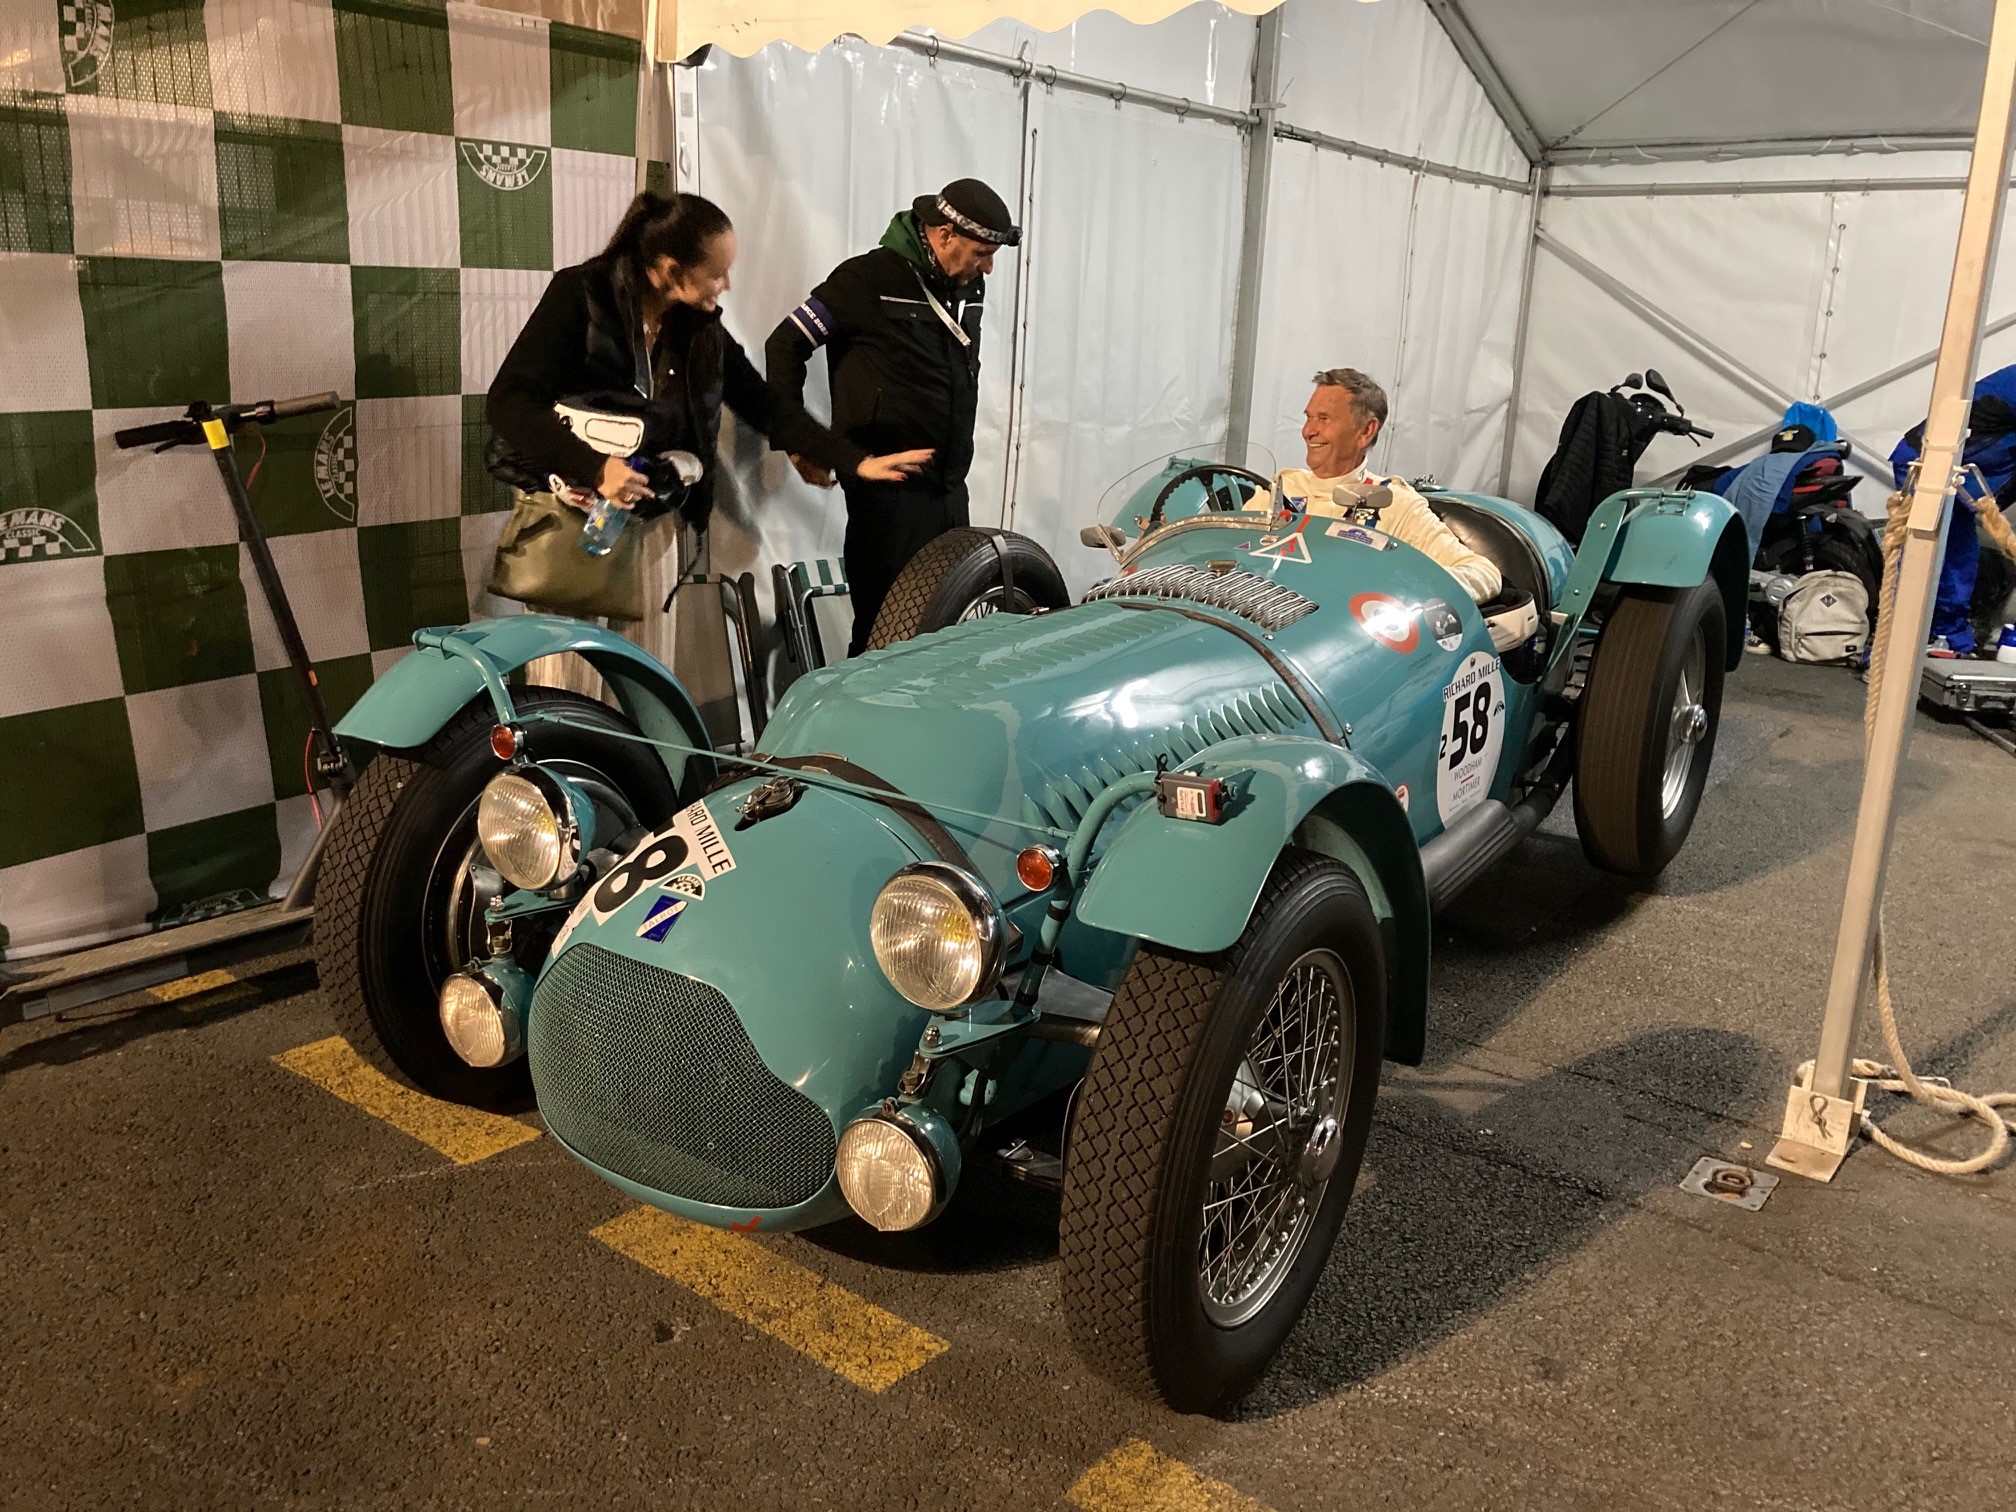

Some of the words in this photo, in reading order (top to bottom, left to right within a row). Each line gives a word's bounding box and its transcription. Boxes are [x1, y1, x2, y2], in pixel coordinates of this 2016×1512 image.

[5, 528, 40, 539] CLASSIC
[1443, 671, 1476, 701] RICHARD
[1478, 657, 1501, 680] MILLE
[1449, 681, 1492, 771] 58
[1439, 733, 1448, 760] 2
[1452, 776, 1481, 802] MORTIMER
[594, 816, 690, 914] 8
[695, 824, 732, 875] MILLE
[643, 905, 679, 931] TALBOT
